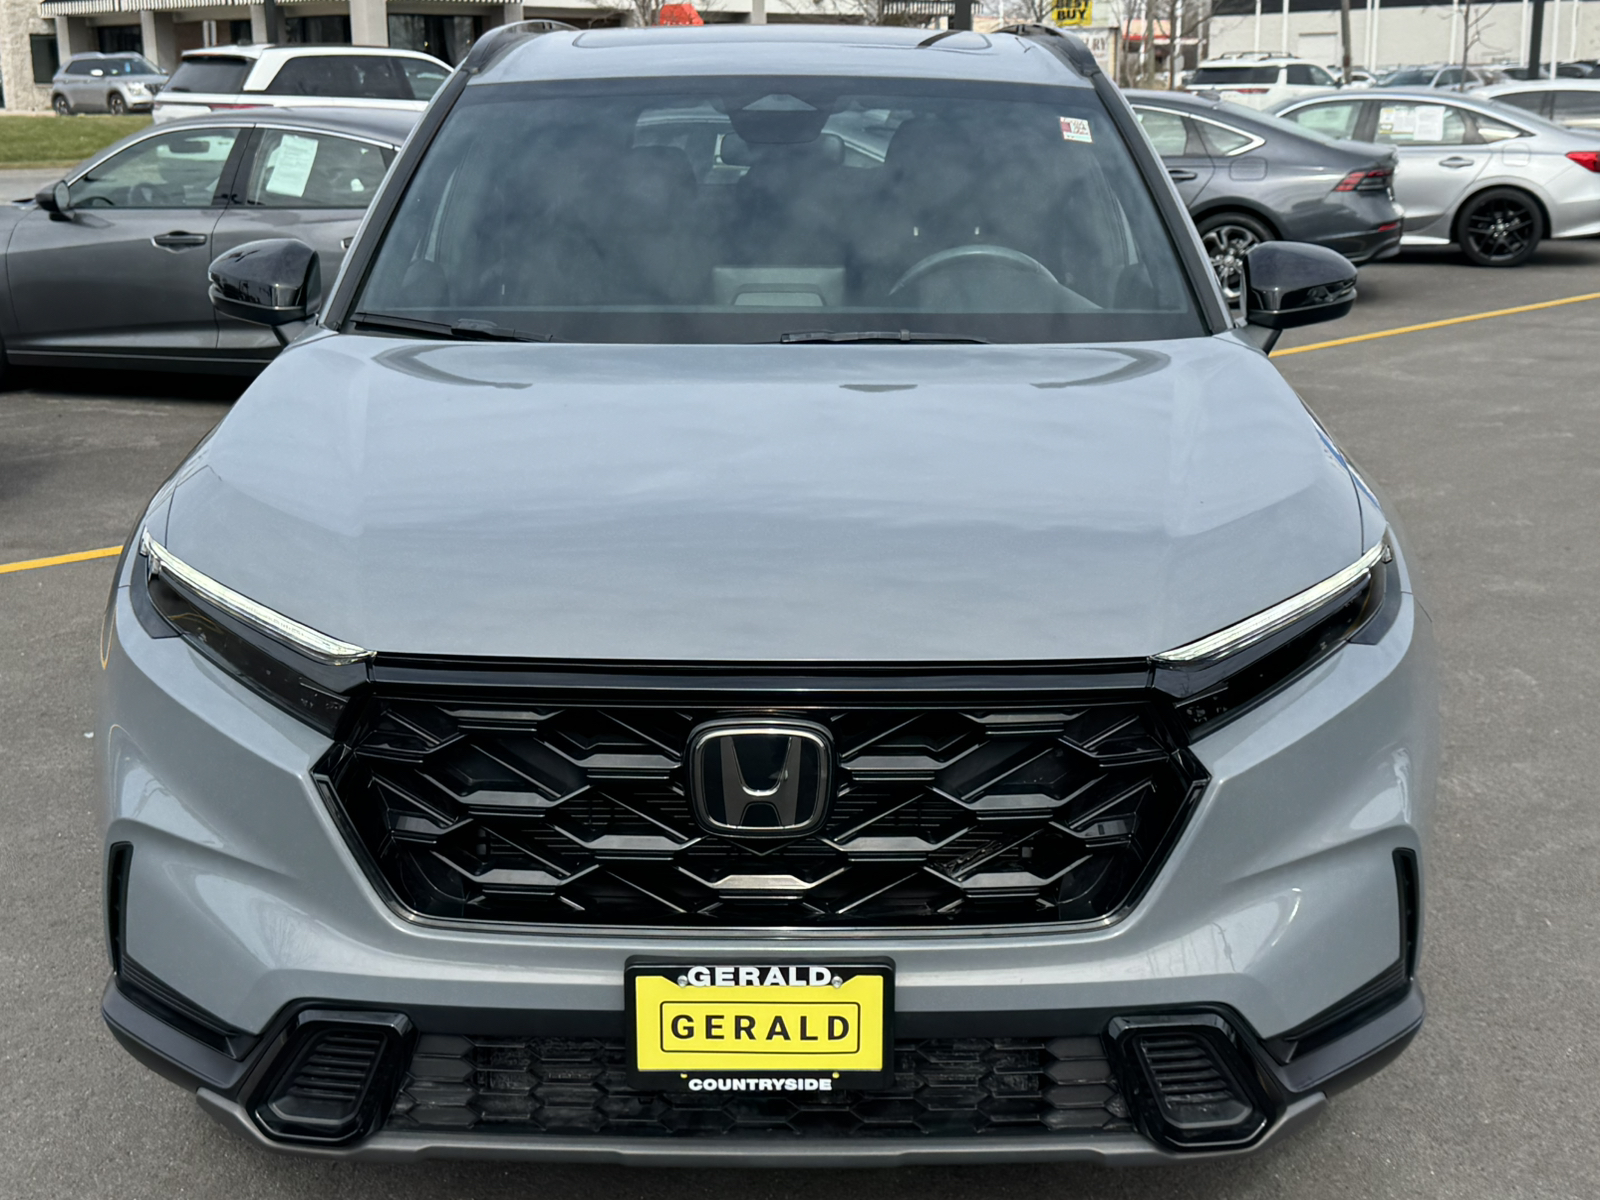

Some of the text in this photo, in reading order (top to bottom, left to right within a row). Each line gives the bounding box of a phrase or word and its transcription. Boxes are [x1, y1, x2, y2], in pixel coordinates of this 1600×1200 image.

[1057, 10, 1086, 20] BUY
[687, 966, 832, 987] GERALD
[671, 1015, 850, 1041] GERALD
[688, 1078, 833, 1091] COUNTRYSIDE
